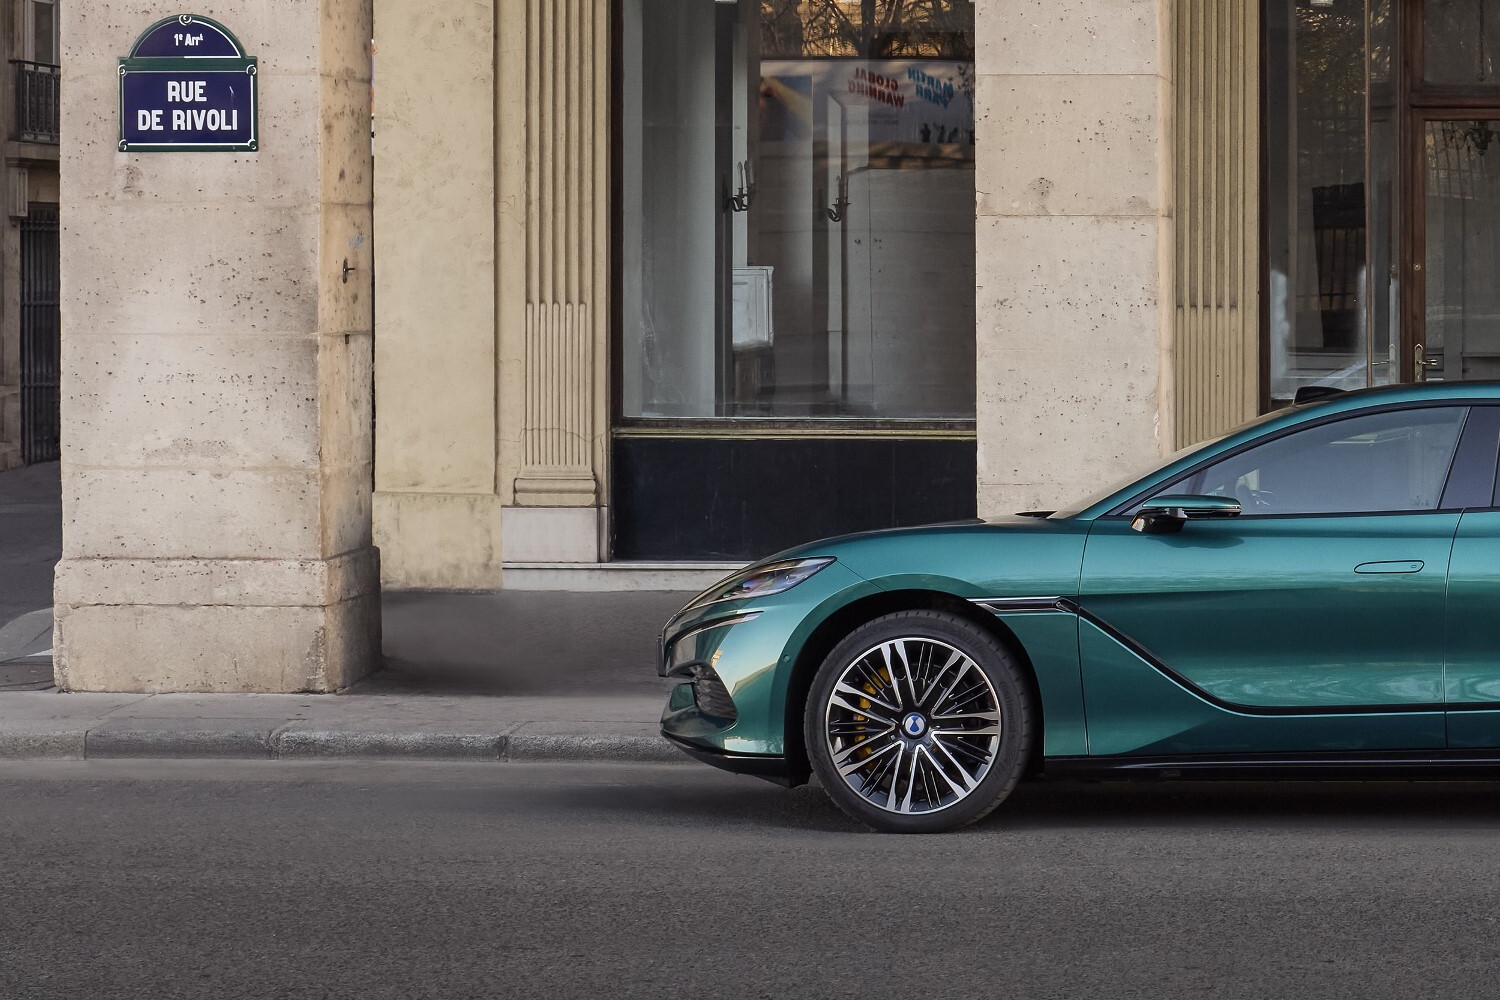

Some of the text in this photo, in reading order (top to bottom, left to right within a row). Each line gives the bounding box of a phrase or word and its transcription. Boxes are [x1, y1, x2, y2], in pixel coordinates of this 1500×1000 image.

[167, 81, 207, 102] RUE
[137, 109, 238, 131] DE RIVOLI
